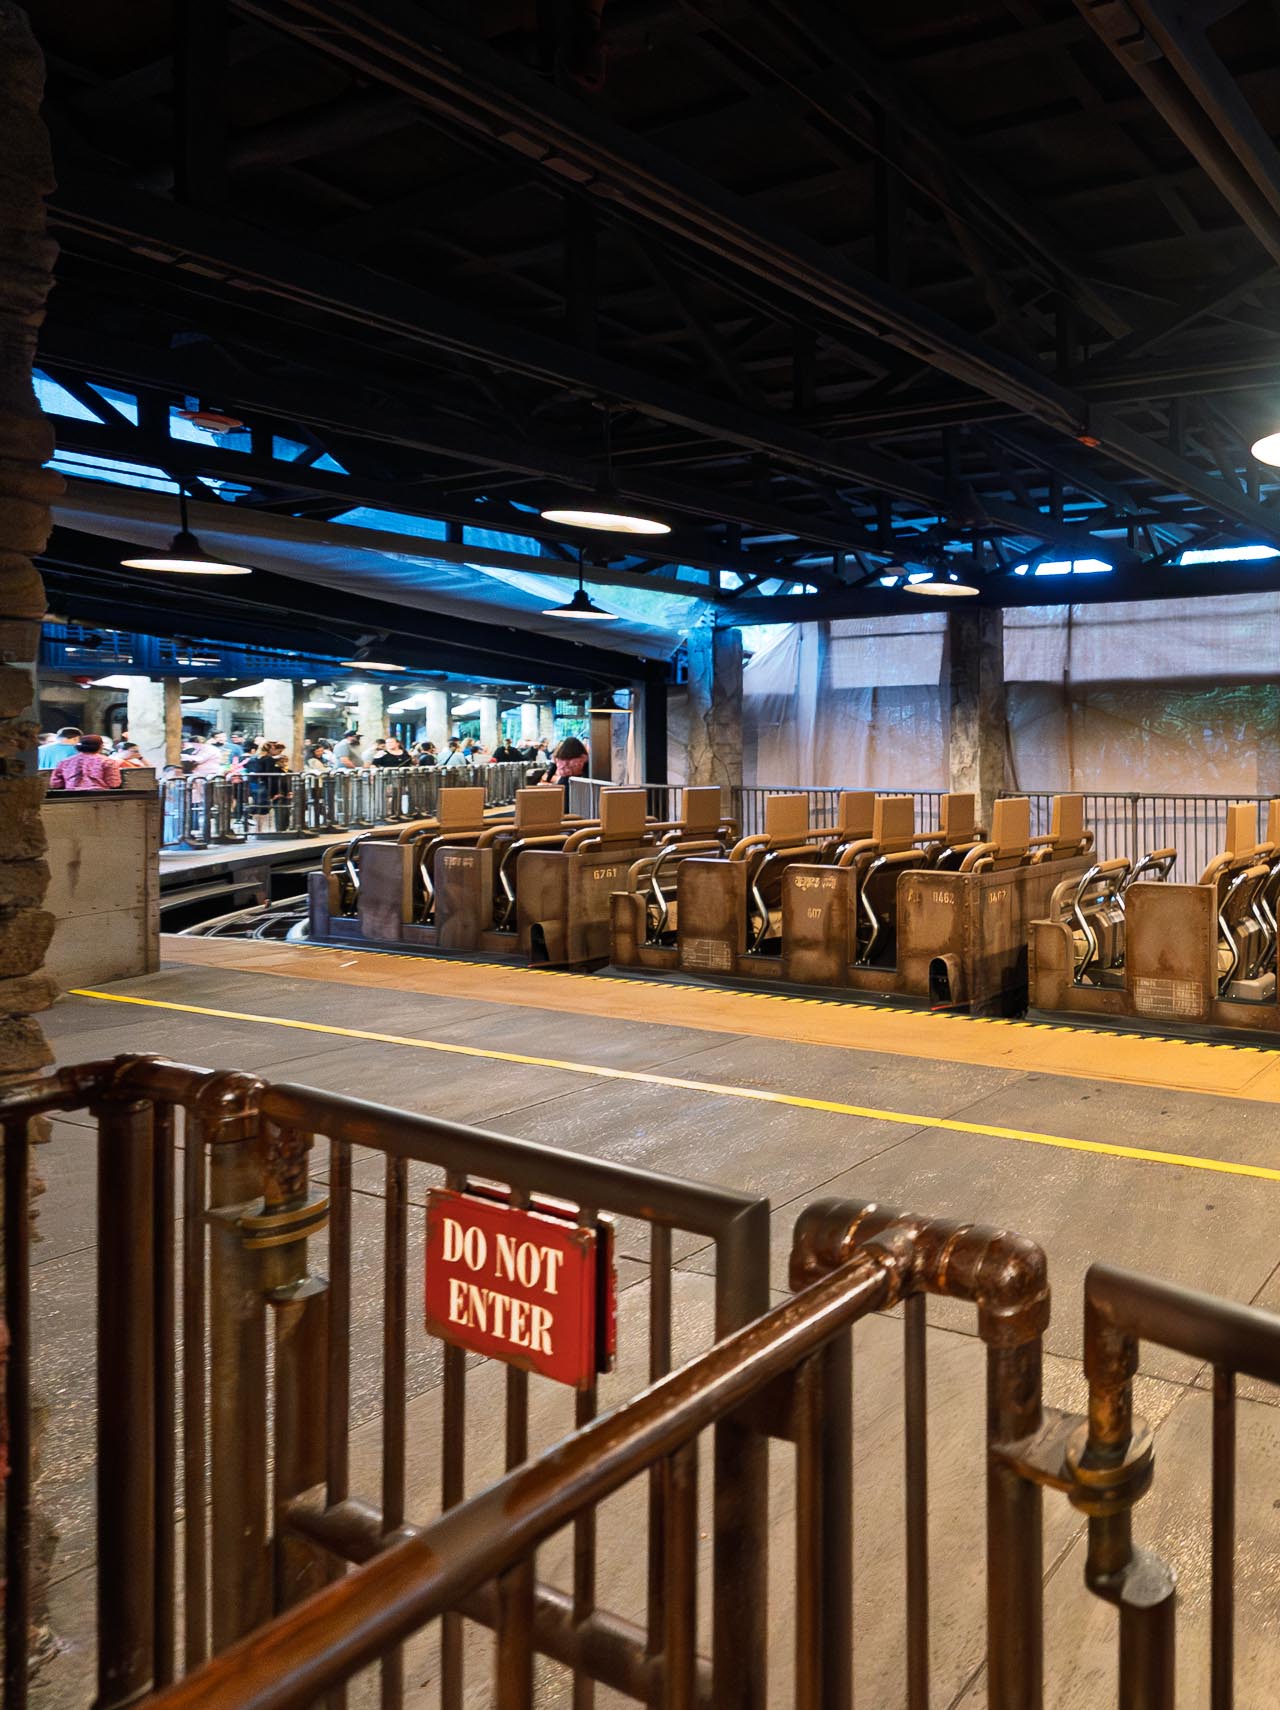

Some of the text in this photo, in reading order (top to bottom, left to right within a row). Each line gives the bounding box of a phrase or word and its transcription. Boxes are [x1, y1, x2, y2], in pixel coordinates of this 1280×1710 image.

[593, 867, 617, 880] 6761
[442, 1217, 564, 1295] DO NOT
[448, 1277, 554, 1356] ENTER
